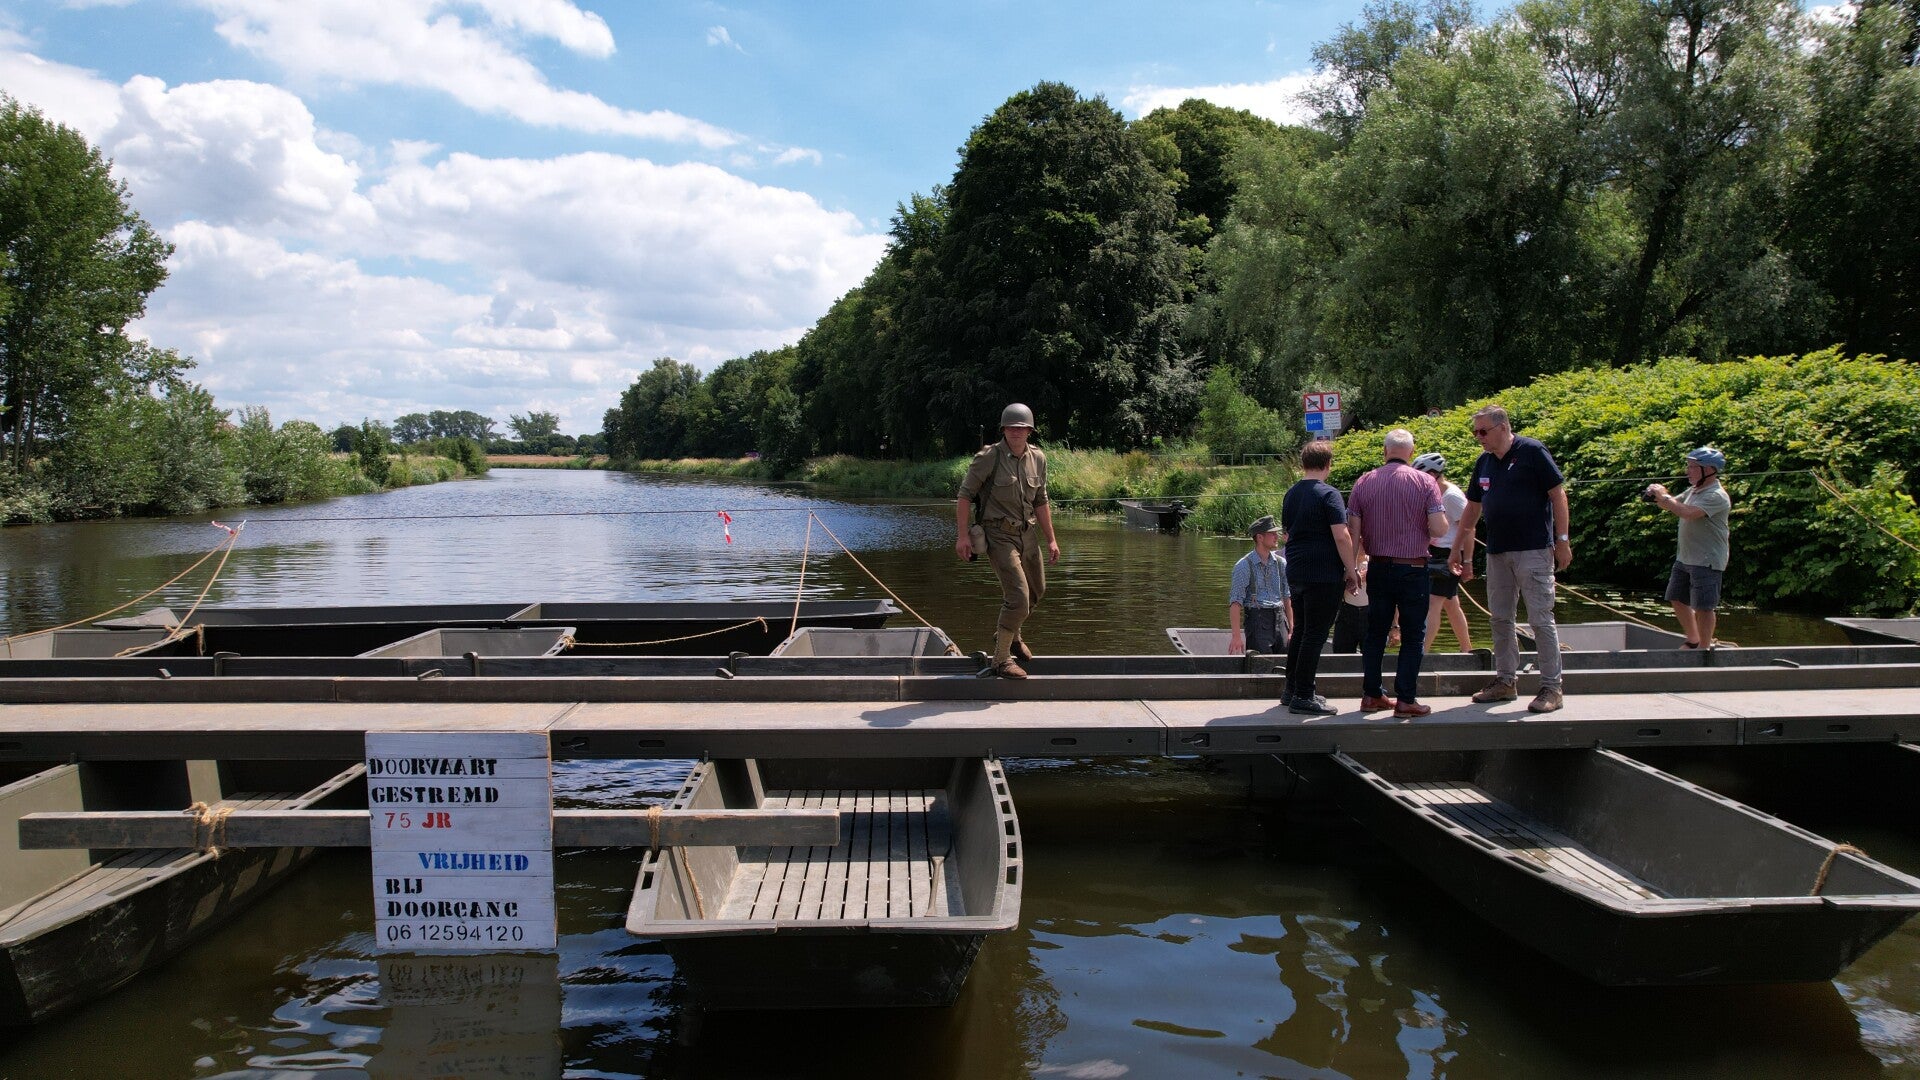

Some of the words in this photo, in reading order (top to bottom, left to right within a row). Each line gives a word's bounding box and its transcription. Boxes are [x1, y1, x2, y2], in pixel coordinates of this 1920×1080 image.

[1327, 396, 1335, 408] 9
[368, 758, 498, 776] DOORVAART
[371, 786, 499, 803] GESTREMD
[384, 812, 411, 829] 75
[422, 812, 452, 829] JR
[418, 852, 529, 871] VRIJHEID
[385, 878, 423, 895] BIJ
